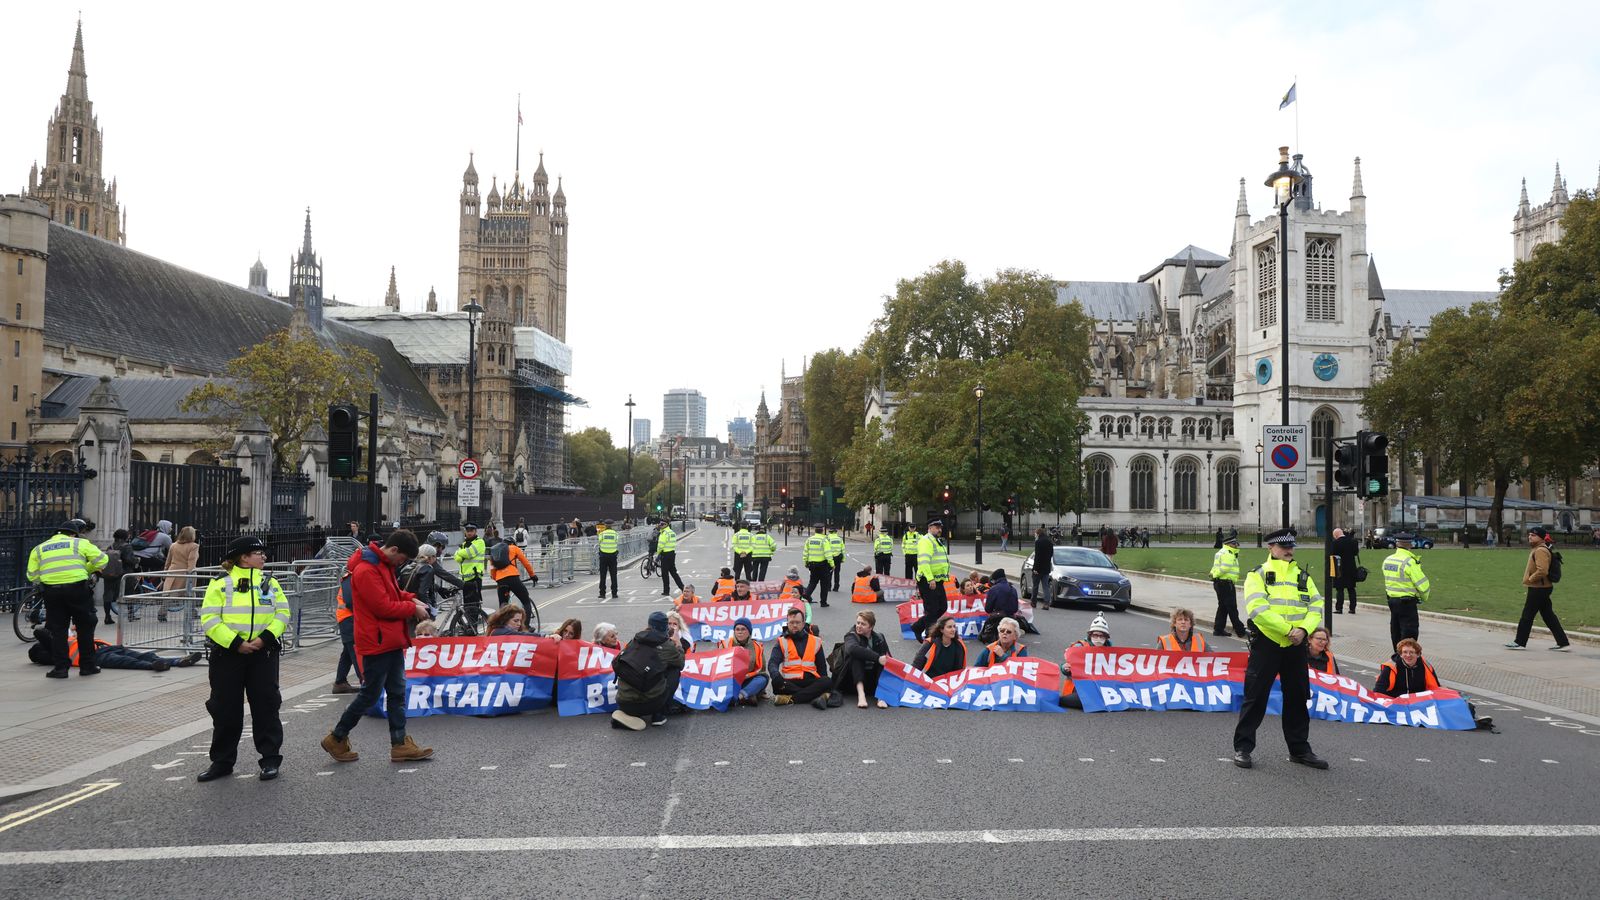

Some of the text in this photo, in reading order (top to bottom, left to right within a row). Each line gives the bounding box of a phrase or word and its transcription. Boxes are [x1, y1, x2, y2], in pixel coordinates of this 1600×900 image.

[692, 602, 794, 622] INSULATE
[1084, 652, 1231, 677] INSULATE
[383, 682, 525, 712] RITAIN
[900, 685, 1037, 708] BRITAIN
[1099, 683, 1232, 708] BRITAIN
[1306, 689, 1439, 727] RITAIN
